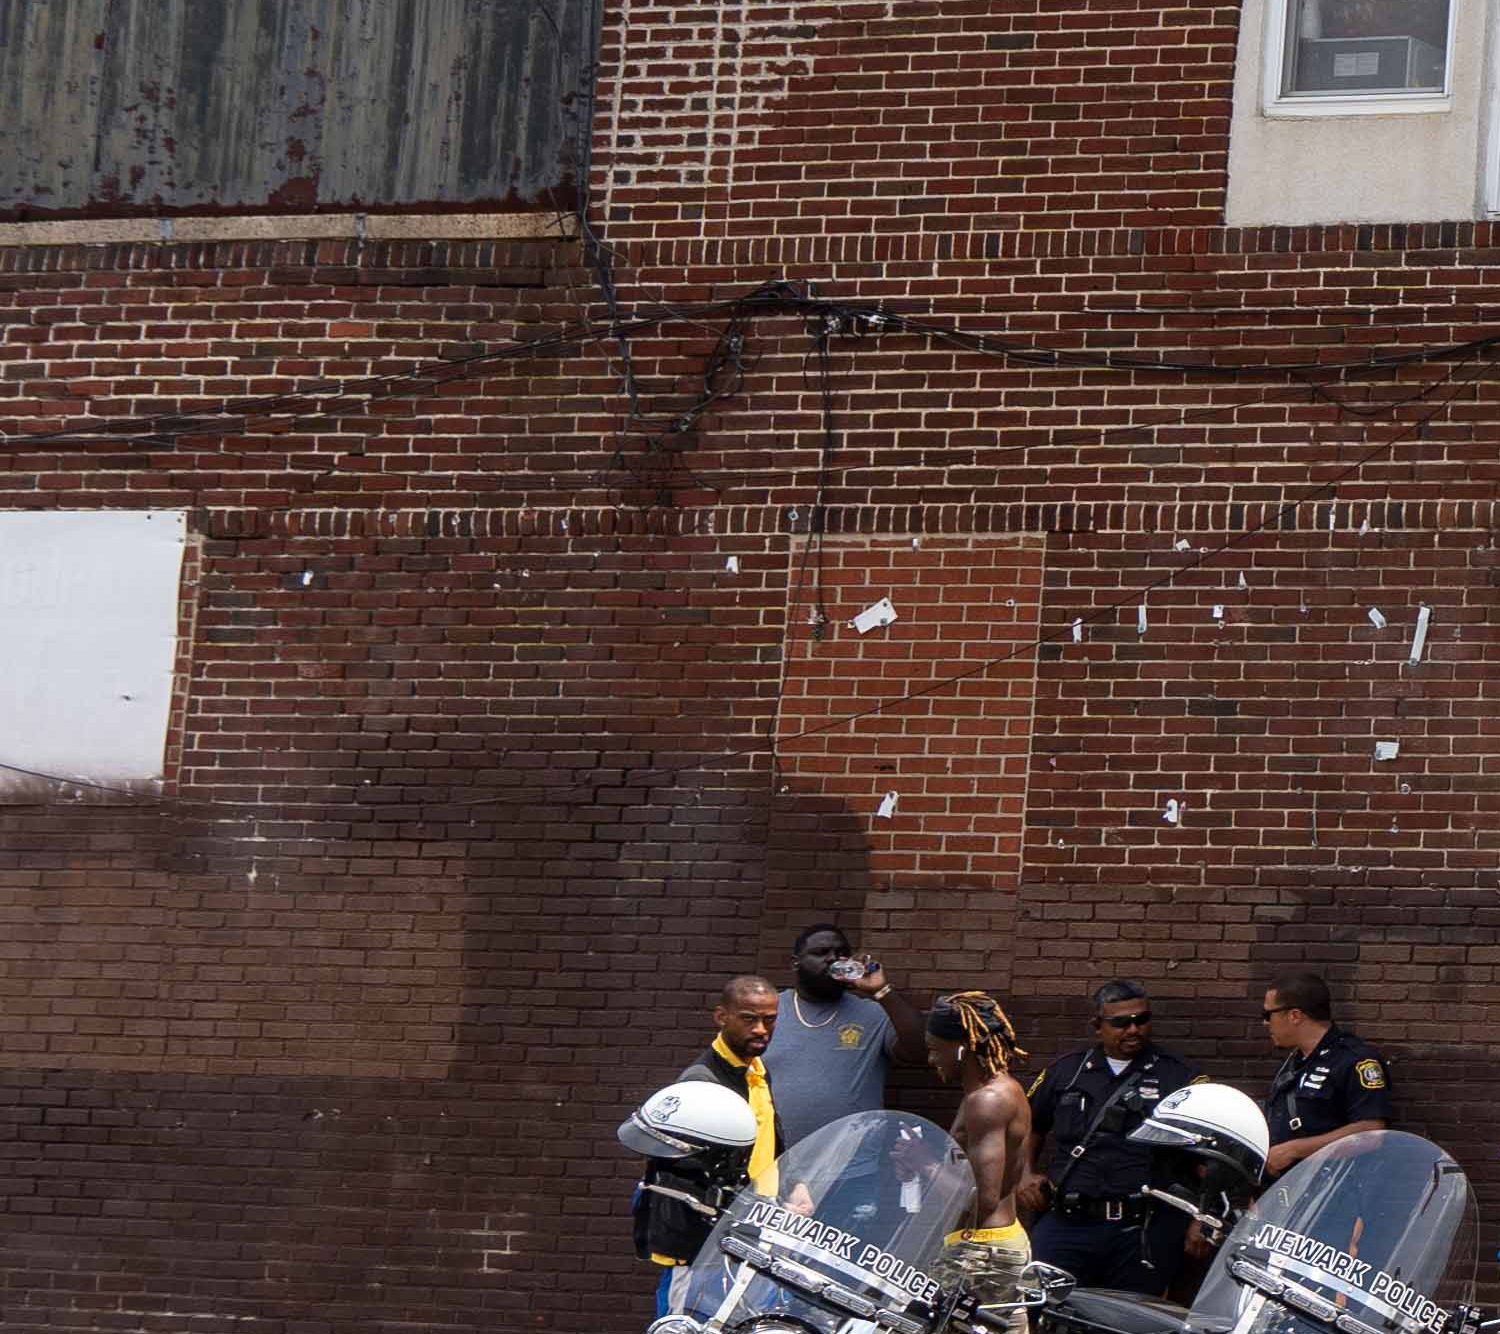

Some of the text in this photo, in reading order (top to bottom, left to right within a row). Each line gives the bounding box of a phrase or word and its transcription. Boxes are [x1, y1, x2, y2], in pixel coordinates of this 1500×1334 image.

[748, 1201, 938, 1304] NEWARK POLICE
[1257, 1224, 1448, 1334] NEWARK POLICE
